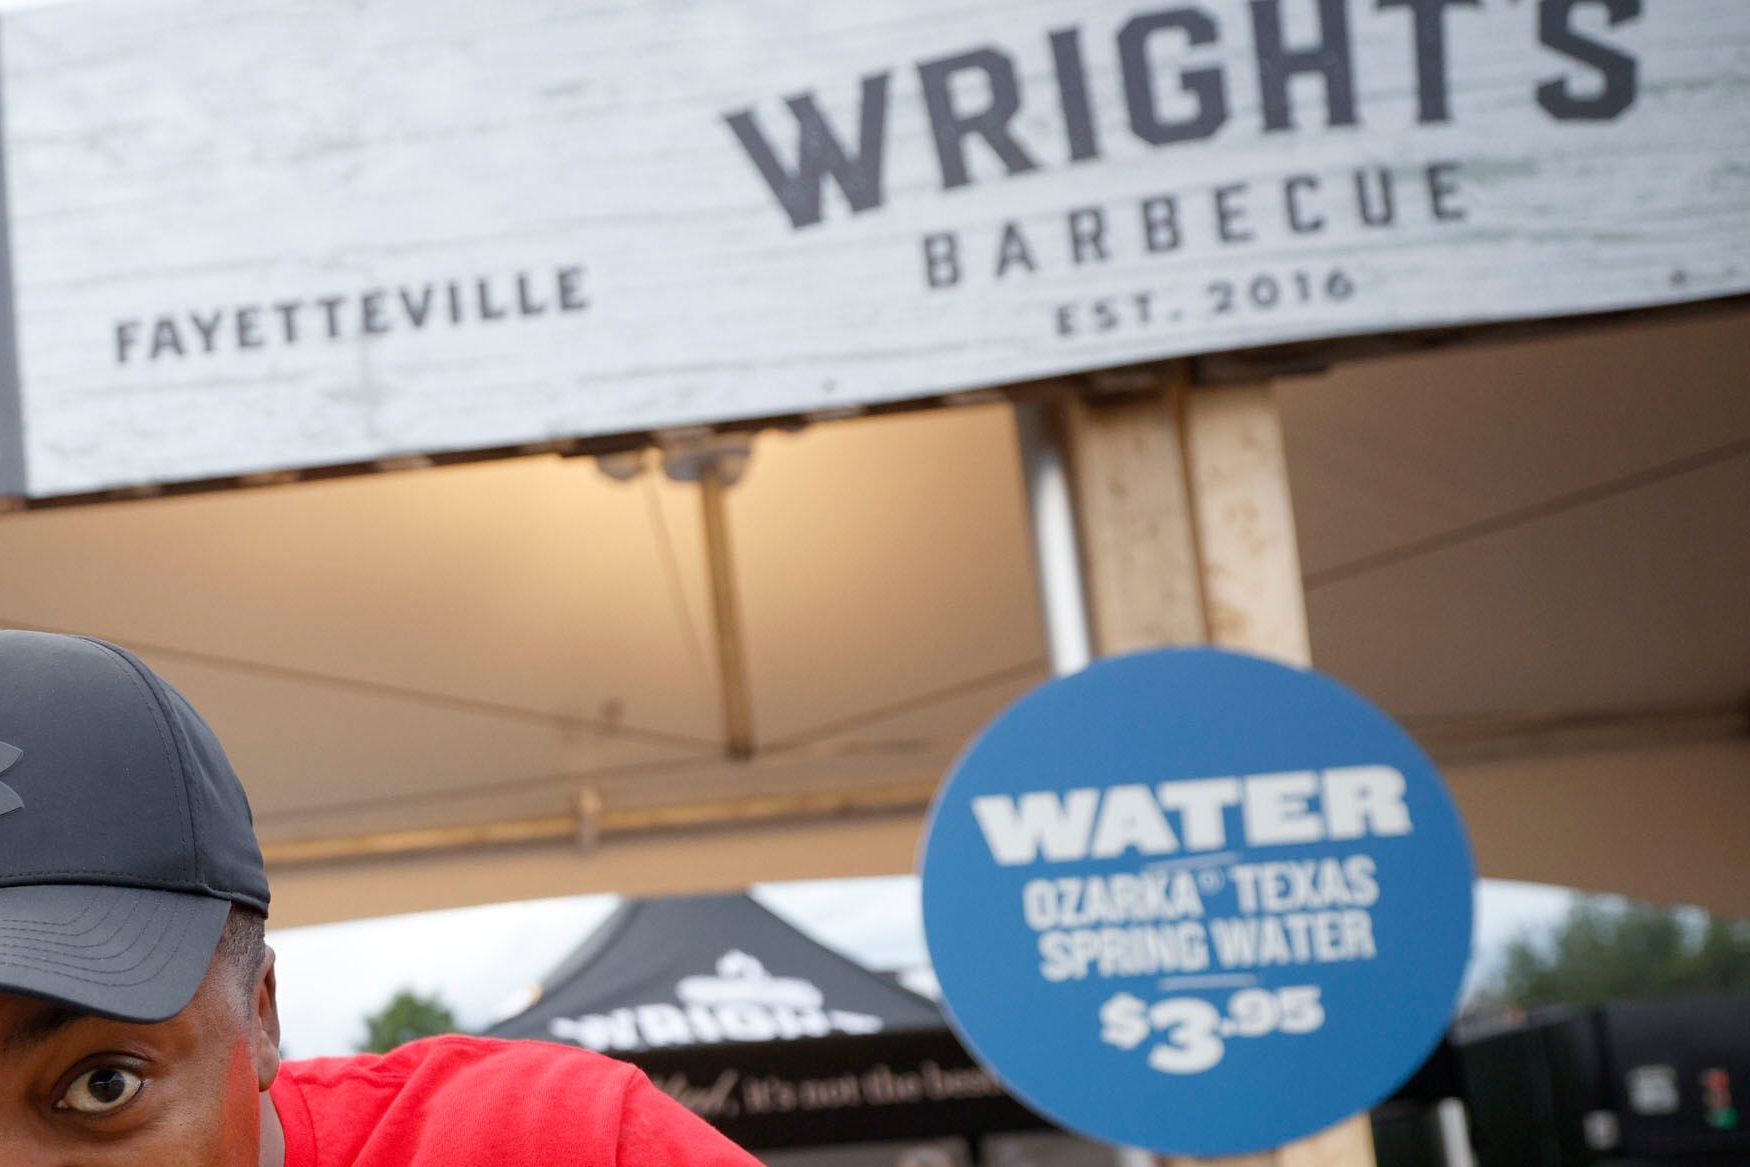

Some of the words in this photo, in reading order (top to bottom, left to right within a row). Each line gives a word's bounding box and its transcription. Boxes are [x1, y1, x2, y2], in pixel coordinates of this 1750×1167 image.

[723, 0, 1642, 230] WRIGHTS
[923, 159, 1467, 290] BARBECUE
[114, 266, 590, 364] FAYETTEVILLE
[1054, 292, 1184, 337] EST.
[1208, 268, 1359, 315] 2016
[970, 764, 1413, 867] WATER
[1229, 854, 1381, 914] TEXAS
[1037, 919, 1210, 983] SPRING
[1209, 908, 1379, 969] WATER
[1099, 985, 1325, 1075] $3.95
